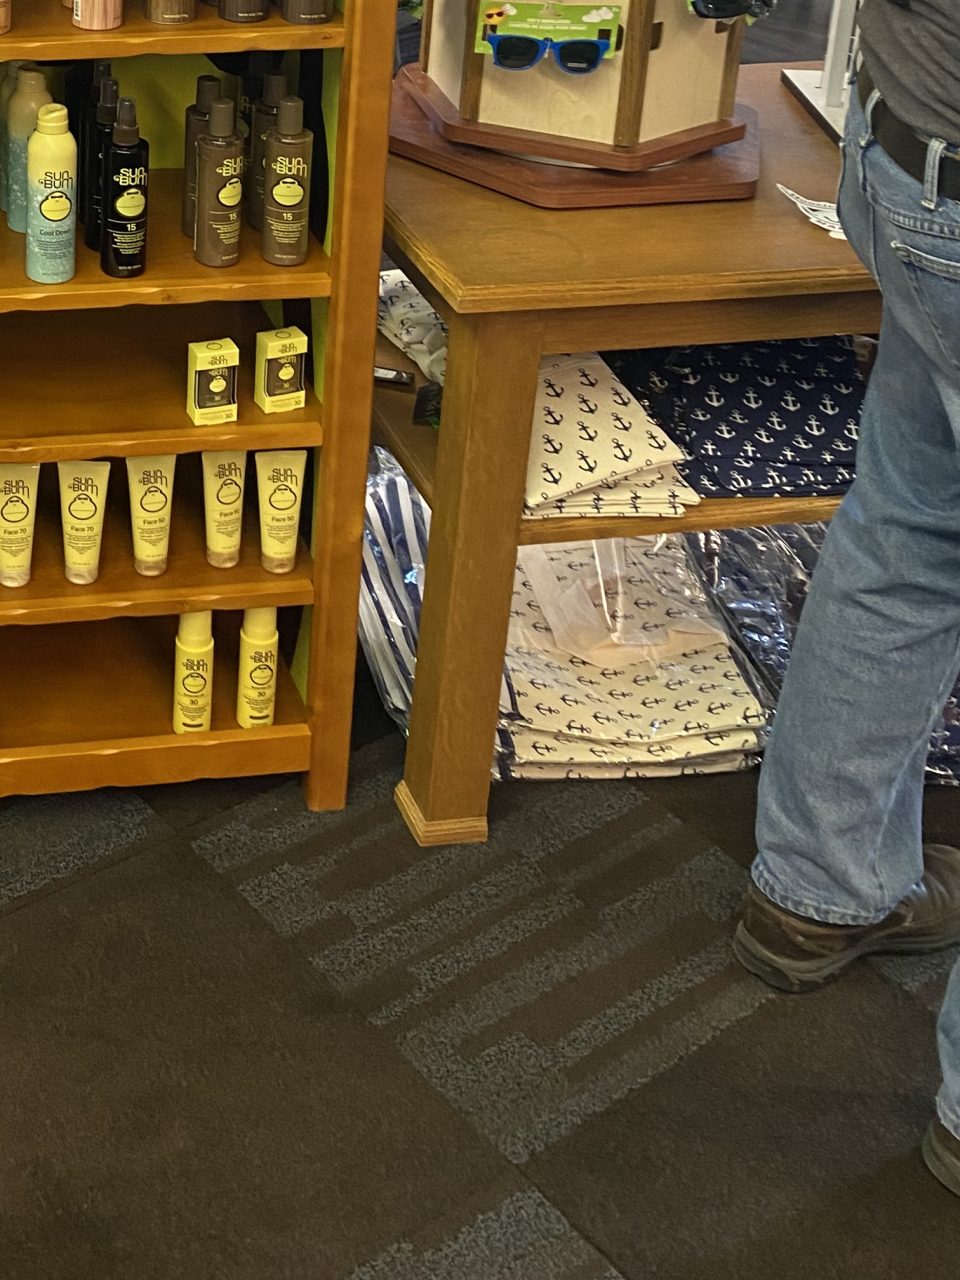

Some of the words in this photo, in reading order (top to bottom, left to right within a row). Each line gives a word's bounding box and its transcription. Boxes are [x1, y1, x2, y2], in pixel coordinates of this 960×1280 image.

[229, 212, 238, 220] 15
[282, 212, 293, 220] 15
[126, 223, 137, 232] 15
[39, 229, 54, 237] Cool
[55, 228, 72, 236] Down
[220, 510, 234, 518] Face
